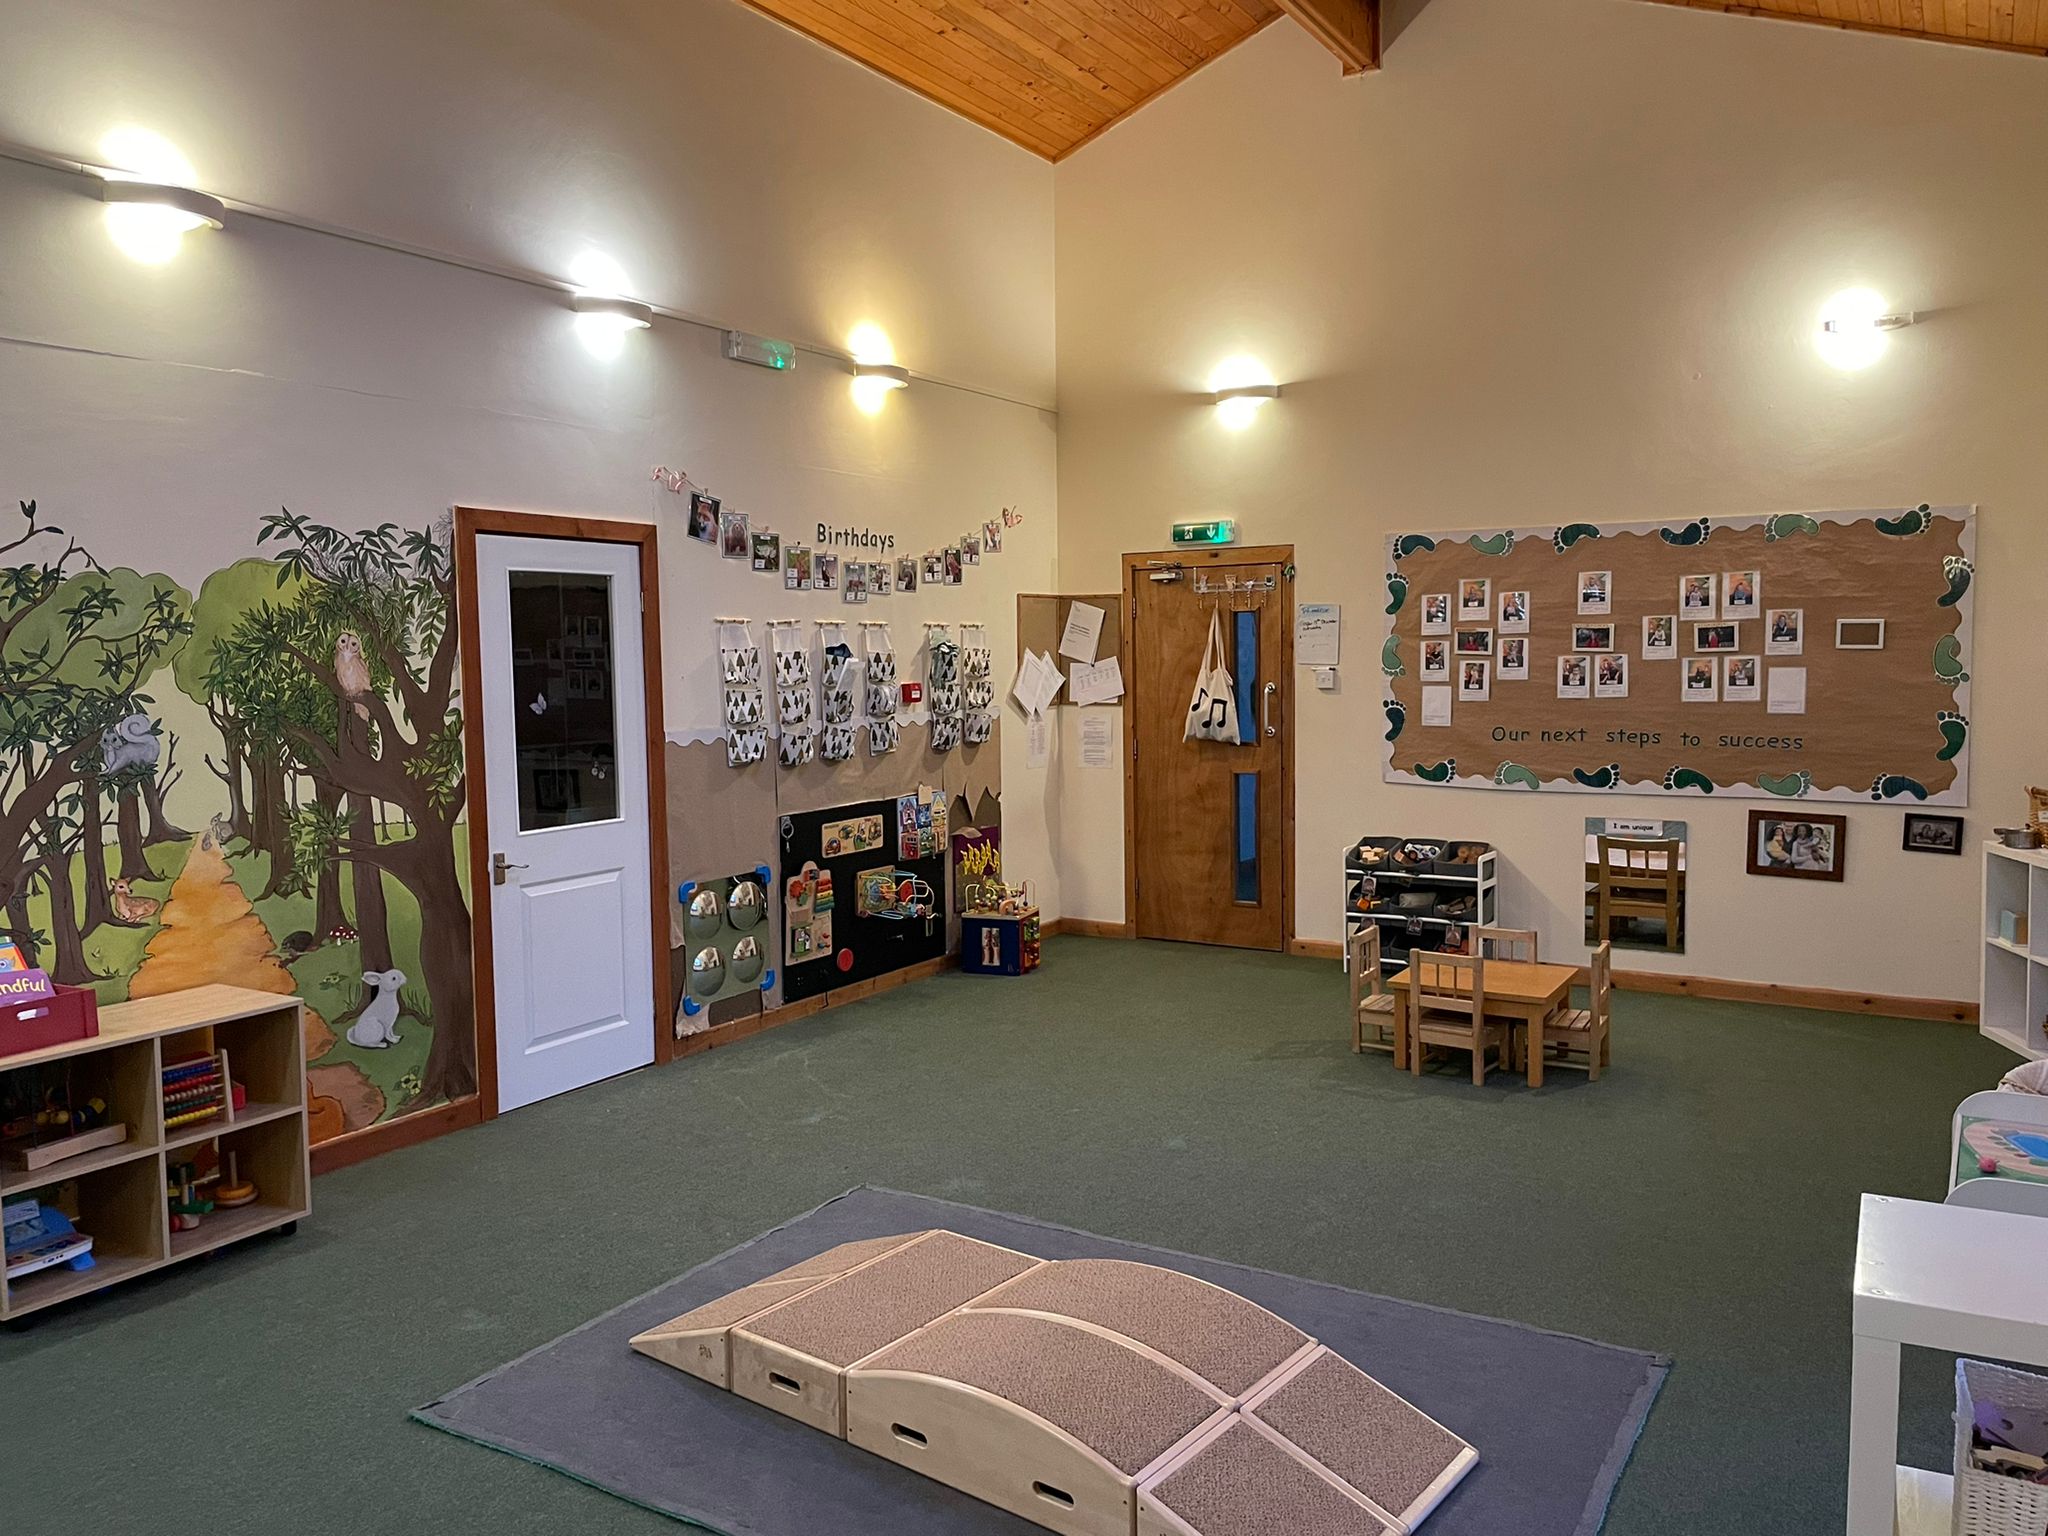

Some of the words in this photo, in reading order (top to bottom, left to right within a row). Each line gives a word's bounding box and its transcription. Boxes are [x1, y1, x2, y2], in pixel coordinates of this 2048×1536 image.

[817, 522, 894, 554] Birthdays
[1492, 726, 1530, 741] Our
[1541, 728, 1587, 742] next
[1606, 729, 1661, 748] steps
[1680, 732, 1700, 746] to
[1719, 735, 1803, 750] success
[0, 977, 46, 995] ndful
